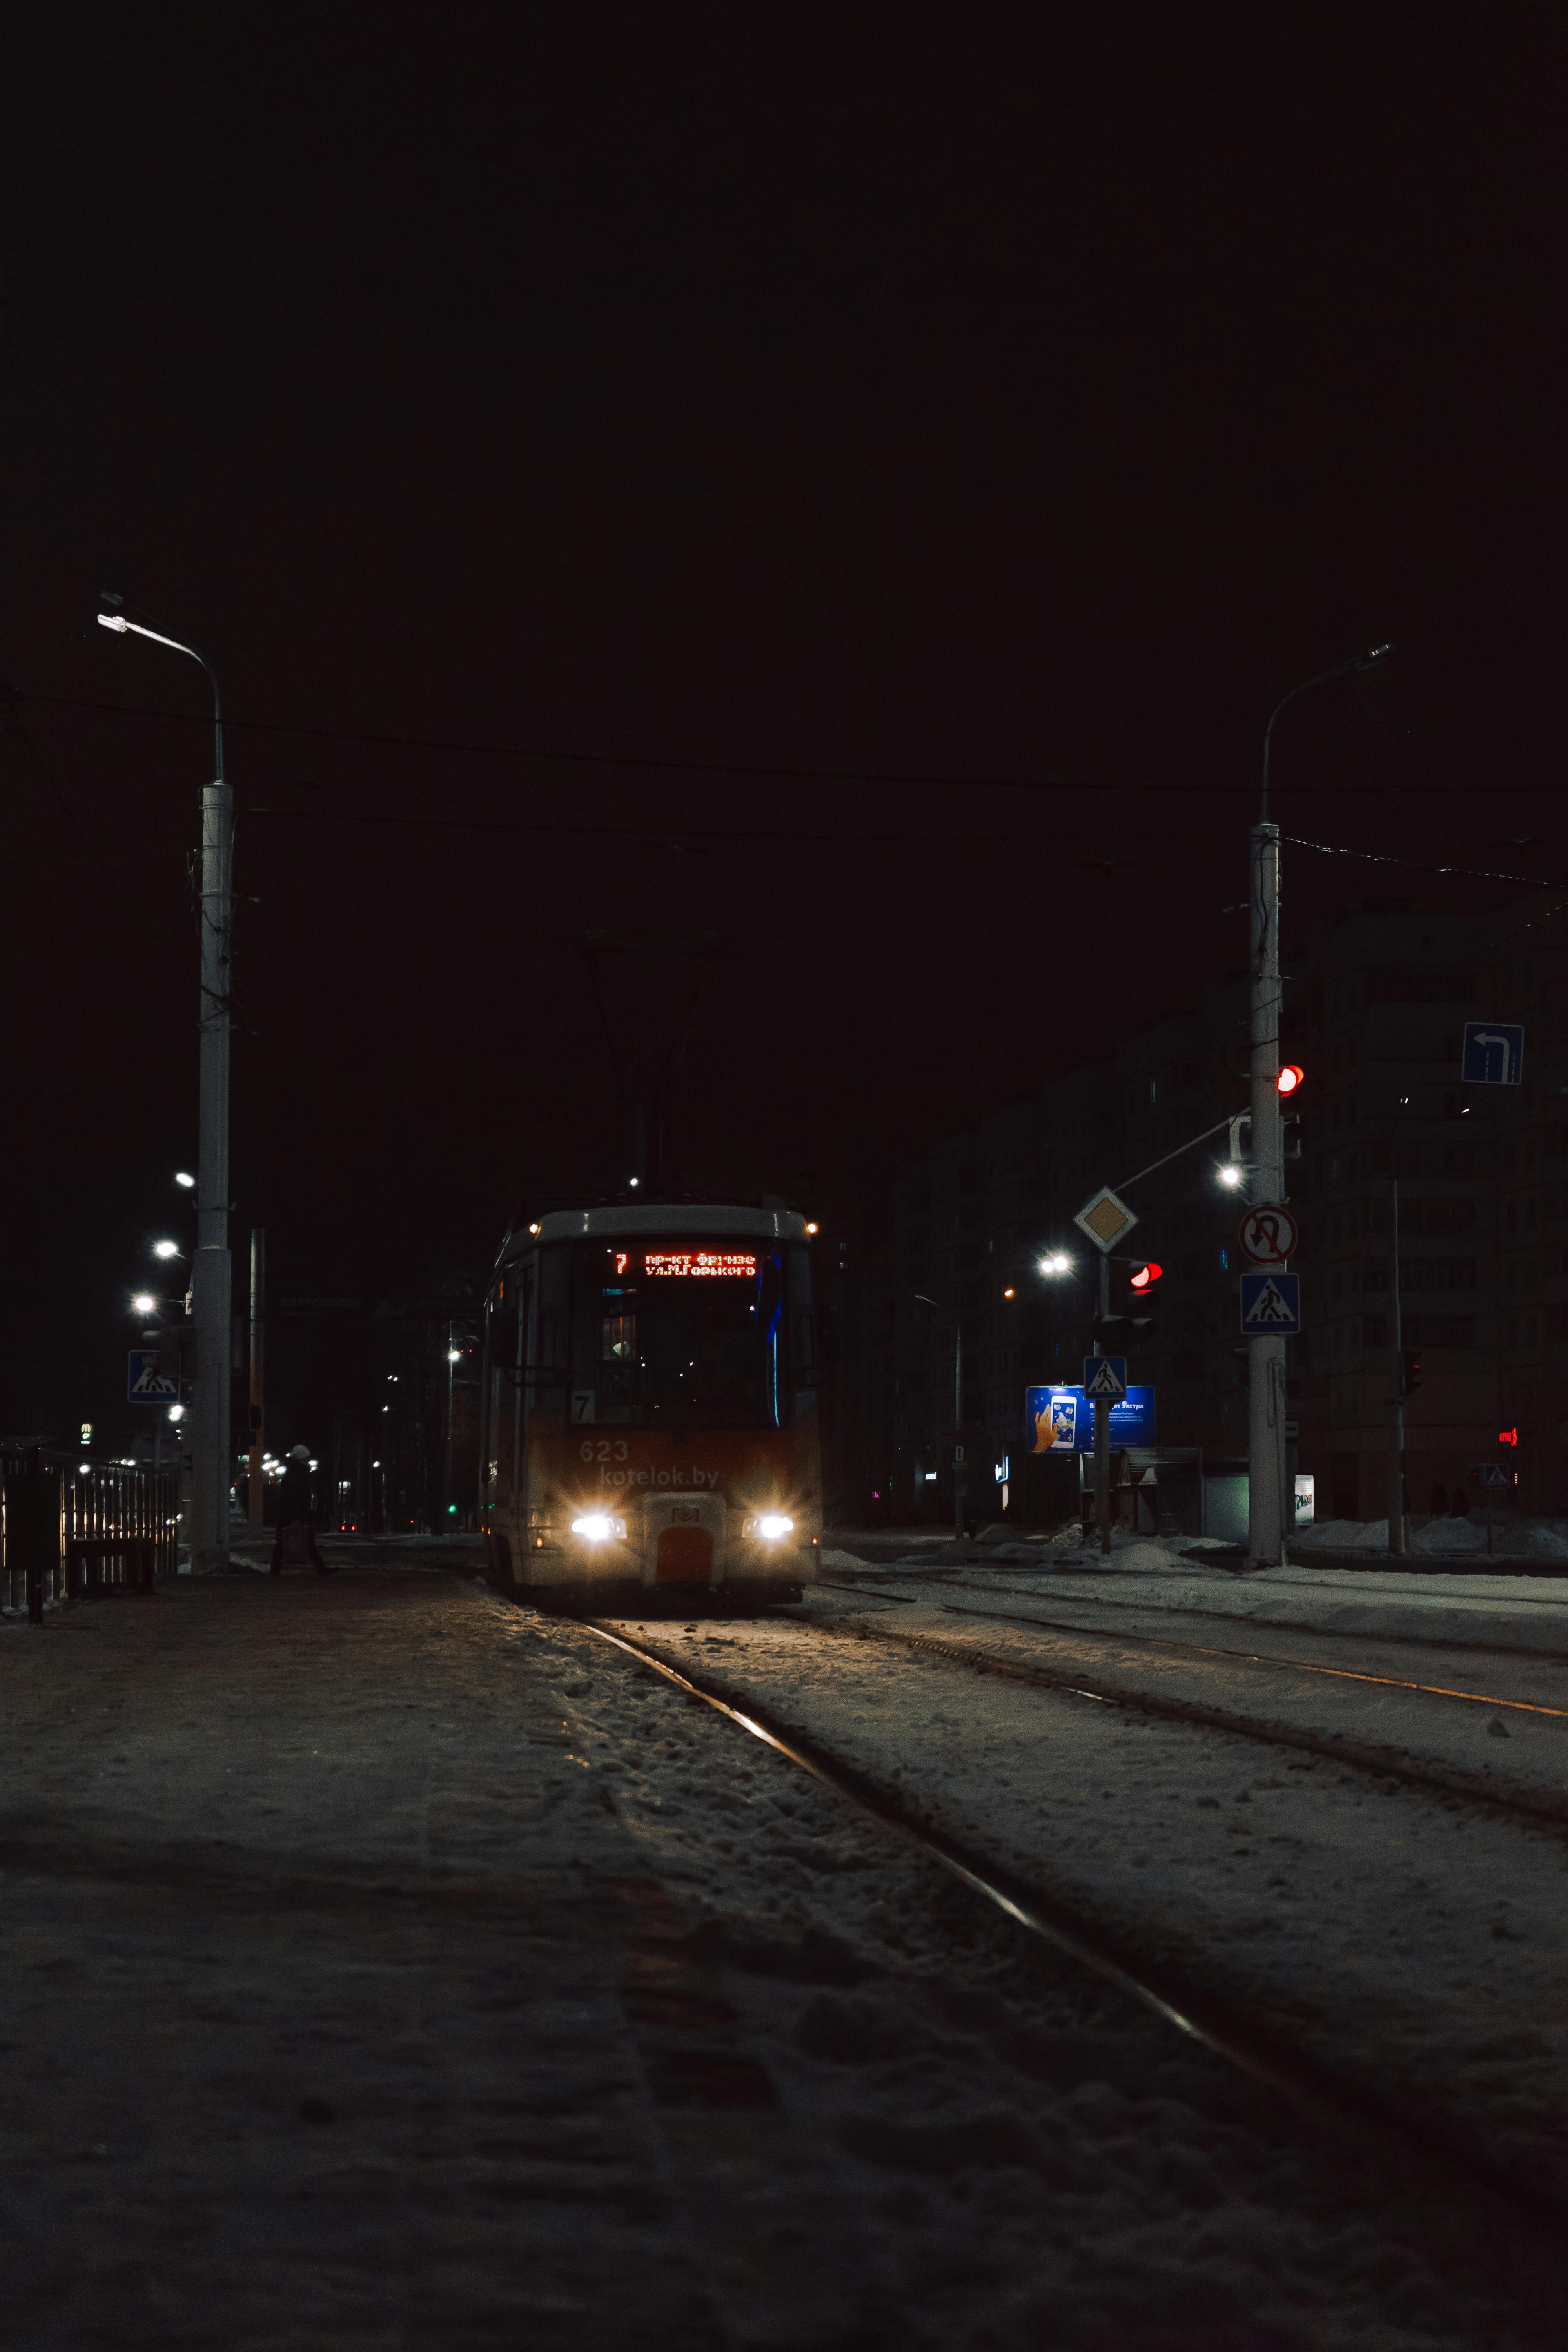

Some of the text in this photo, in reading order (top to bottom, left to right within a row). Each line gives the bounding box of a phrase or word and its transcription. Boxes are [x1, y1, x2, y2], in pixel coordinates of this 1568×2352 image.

[616, 1254, 626, 1274] 7
[645, 1256, 691, 1265] пр-кт
[575, 1396, 591, 1420] 7
[1122, 1401, 1144, 1410] Экстра
[579, 1439, 628, 1462] 623
[600, 1465, 719, 1489] kotelok.by
